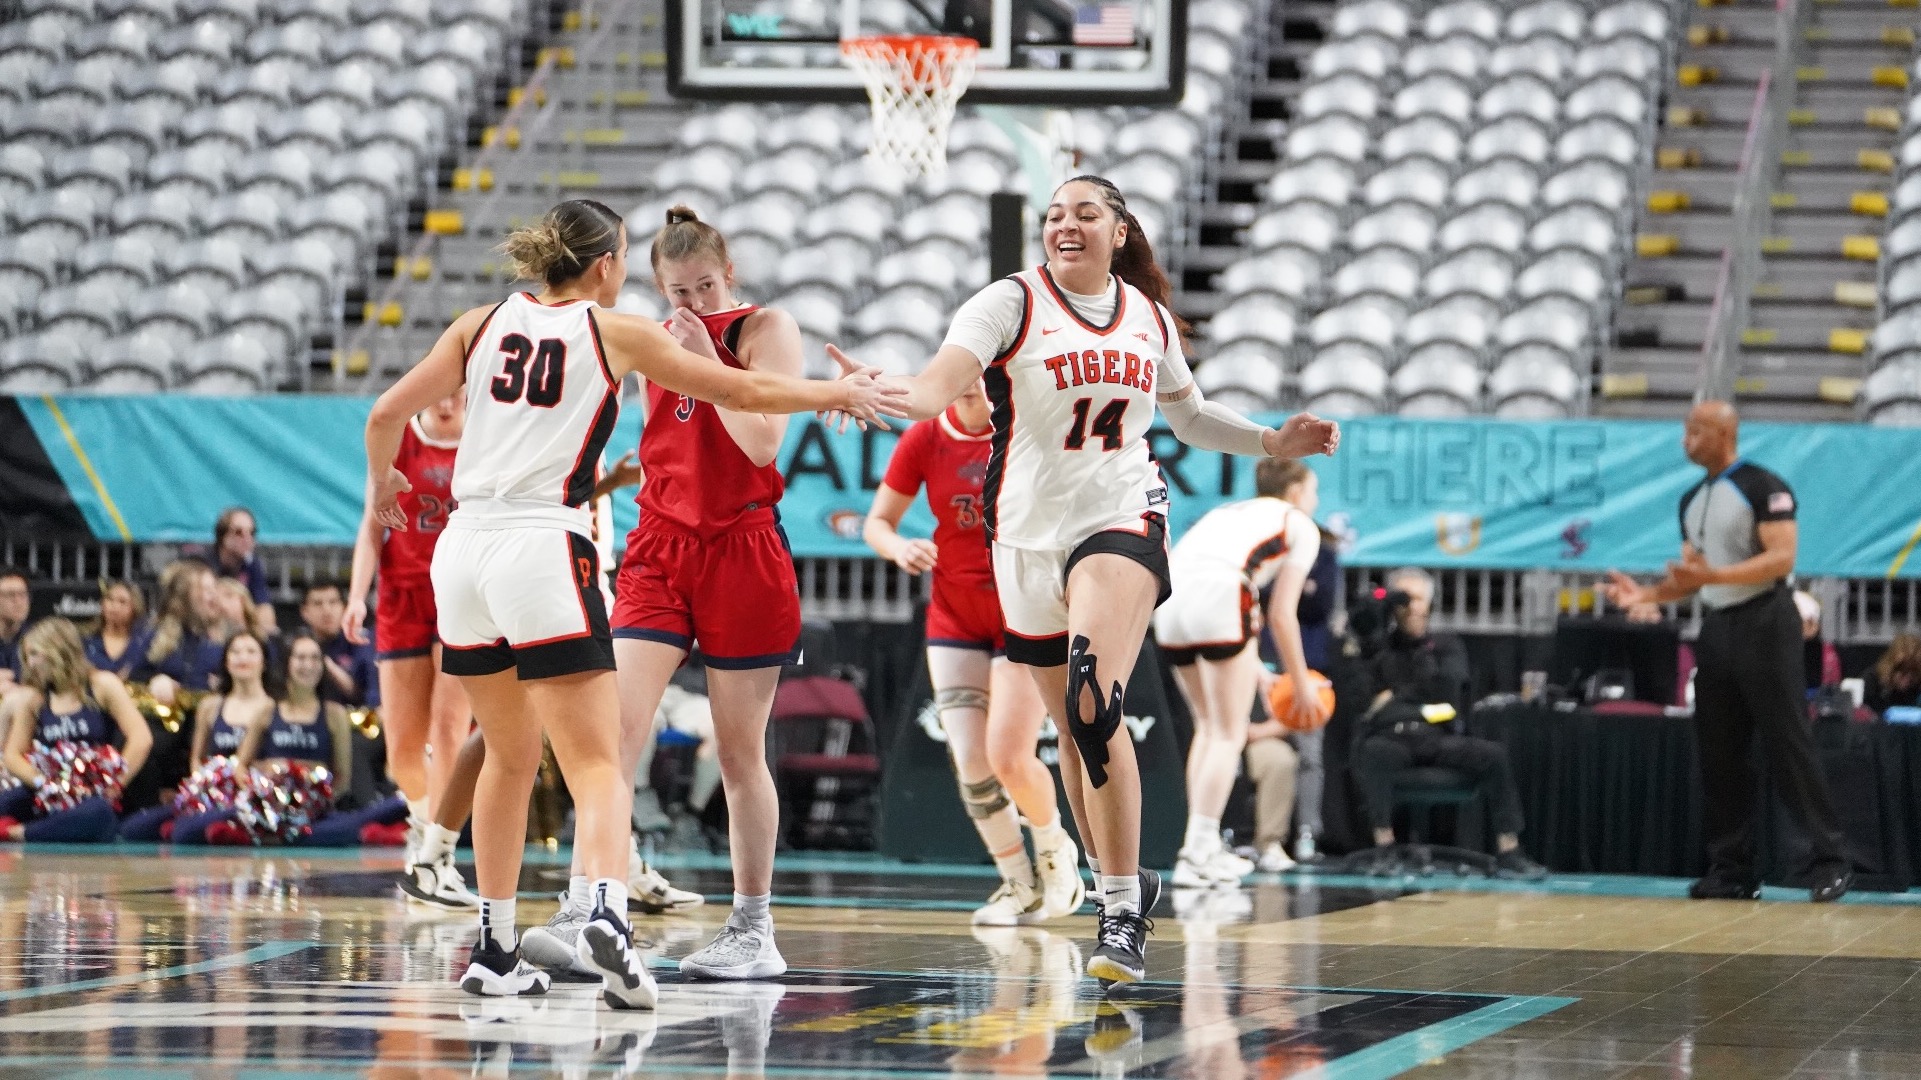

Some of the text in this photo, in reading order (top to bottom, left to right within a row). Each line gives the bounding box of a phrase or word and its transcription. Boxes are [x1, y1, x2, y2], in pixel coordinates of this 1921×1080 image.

[490, 332, 568, 409] 30
[1044, 349, 1154, 394] TIGERS
[1063, 397, 1130, 453] 14
[1340, 421, 1607, 508] HERE
[577, 557, 591, 588] P
